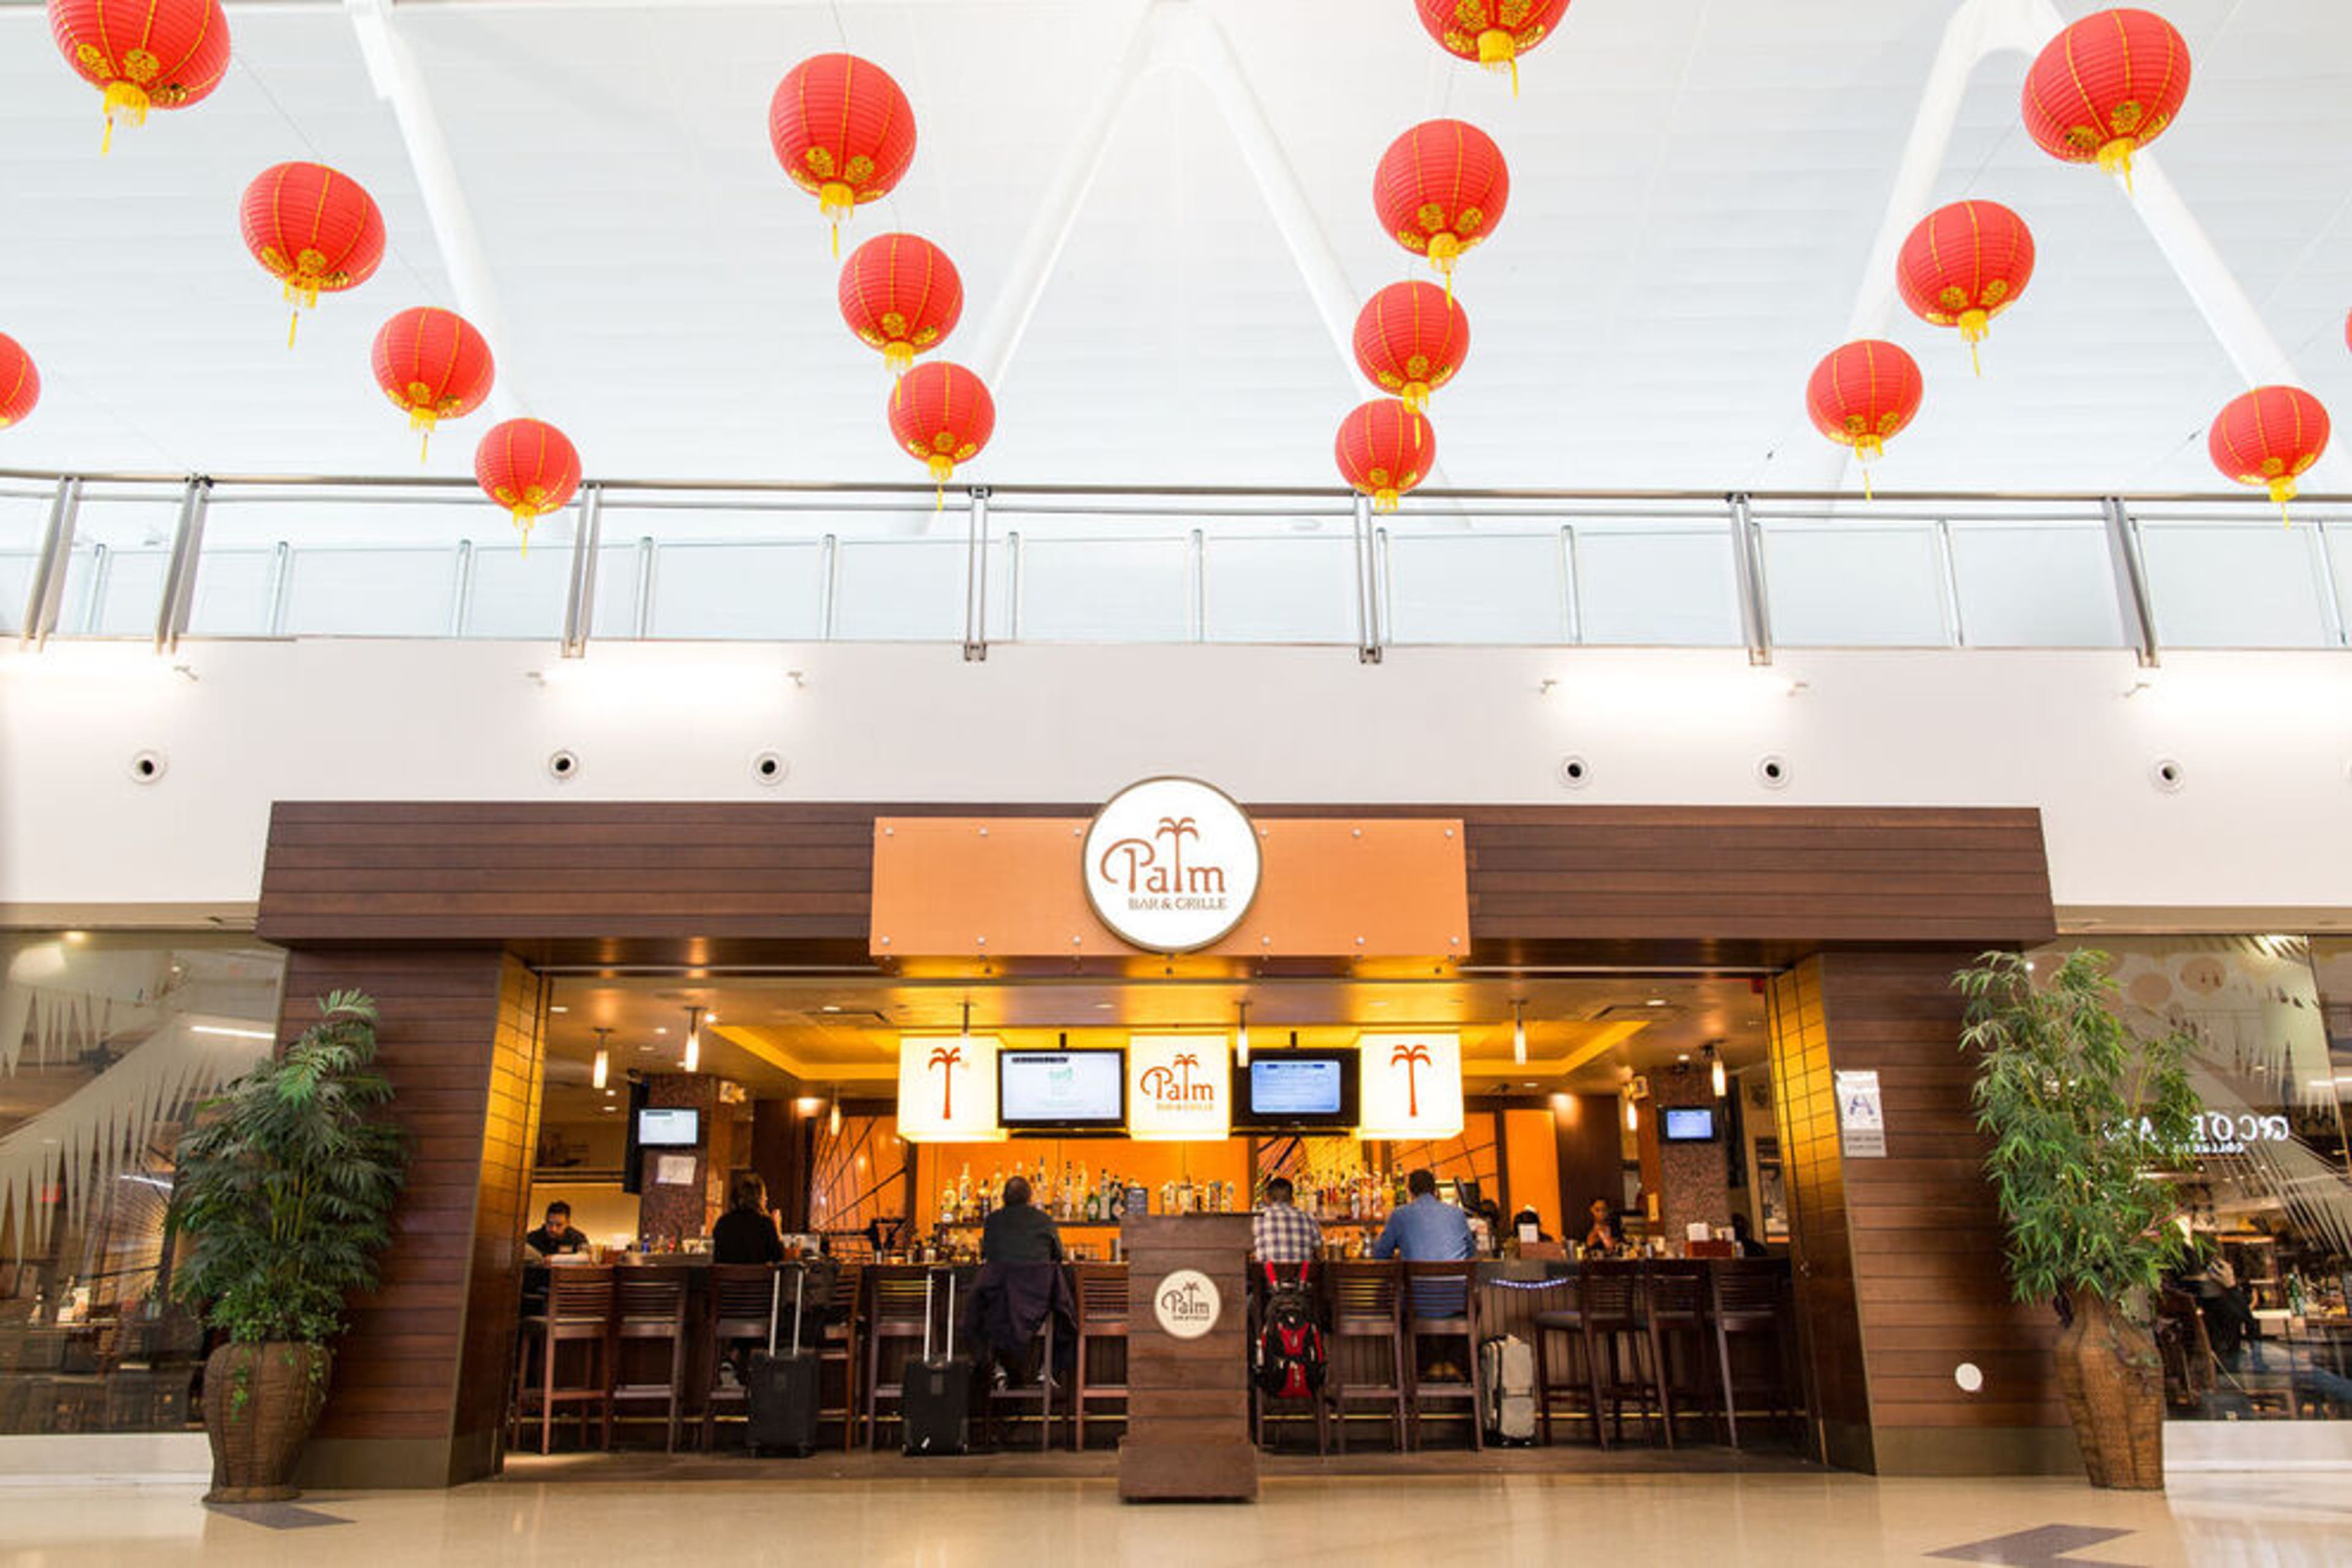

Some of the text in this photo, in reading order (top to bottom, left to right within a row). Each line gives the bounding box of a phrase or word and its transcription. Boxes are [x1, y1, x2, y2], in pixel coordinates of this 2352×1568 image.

[1100, 816, 1226, 894] Palm
[1128, 897, 1229, 911] BAR & GRILLE
[1140, 1054, 1214, 1101] Palm
[1161, 1281, 1210, 1314] Palm
